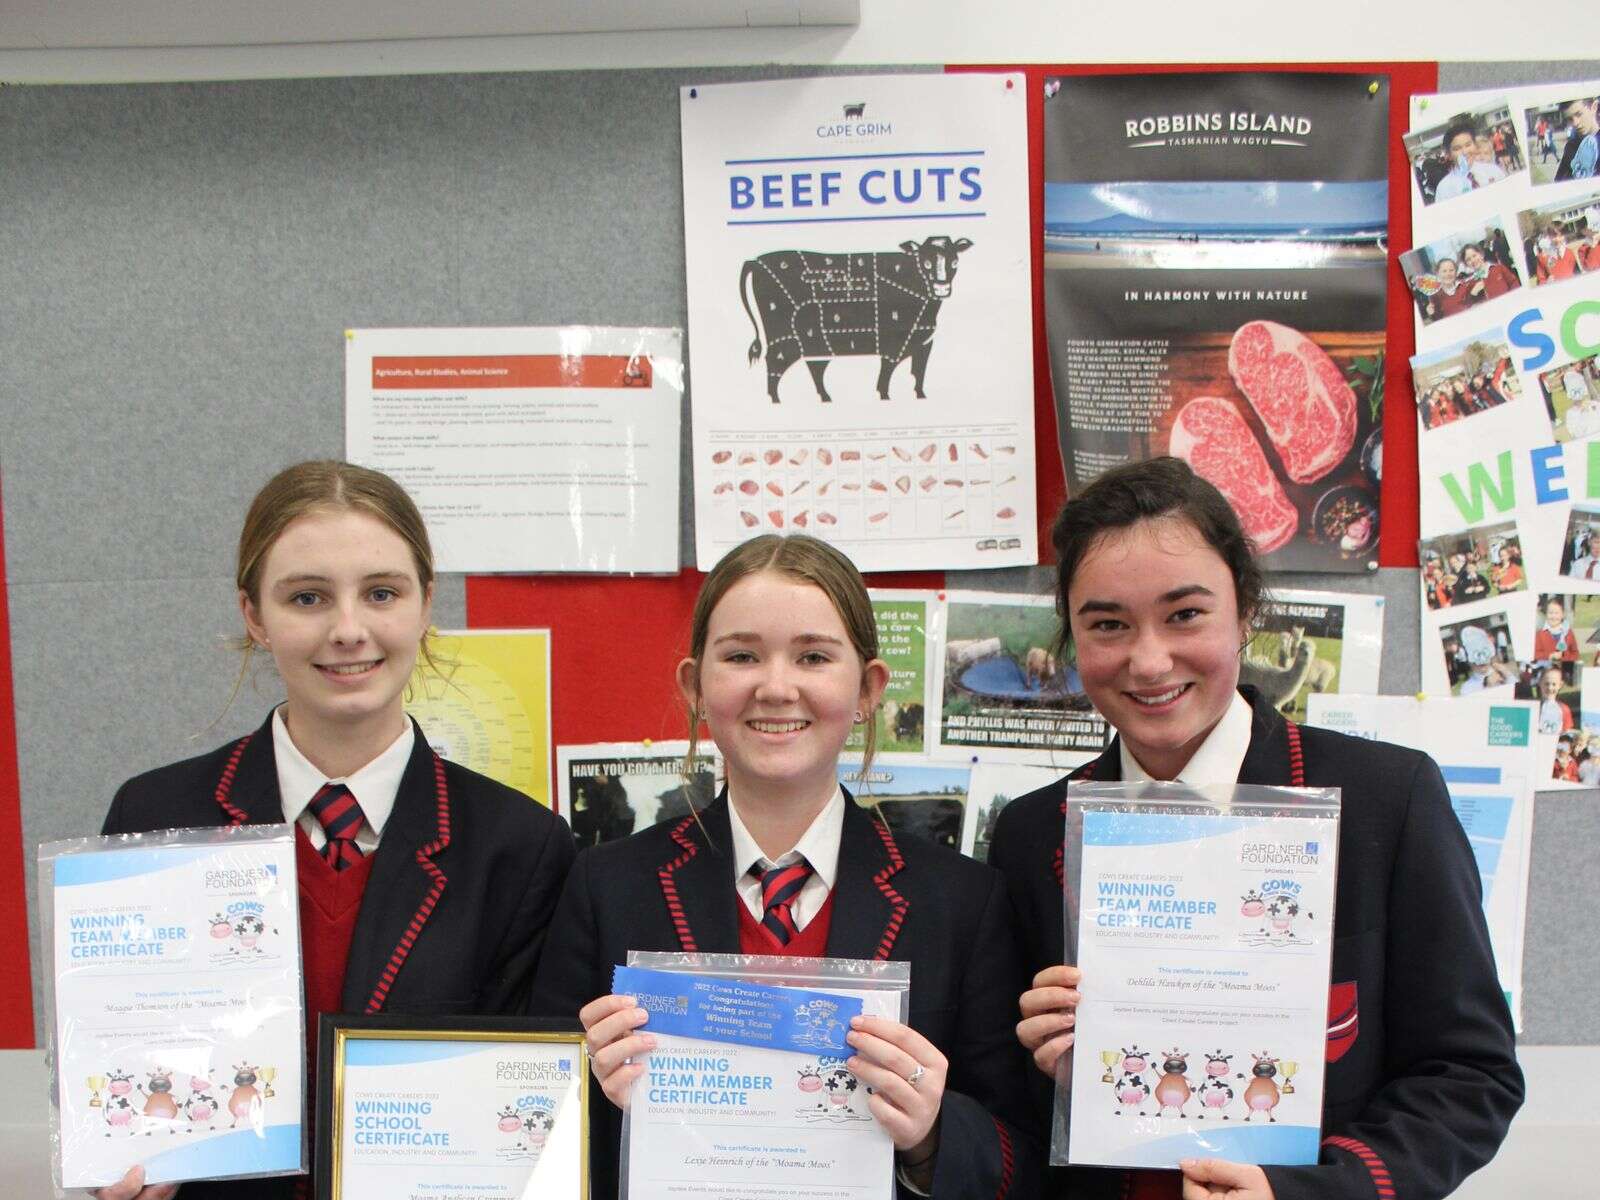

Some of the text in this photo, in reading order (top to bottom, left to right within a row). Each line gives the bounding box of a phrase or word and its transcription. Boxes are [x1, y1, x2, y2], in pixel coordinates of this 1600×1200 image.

[816, 124, 892, 138] CAPE GRIM
[1125, 112, 1312, 137] ROBBINS ISLAND
[1168, 137, 1268, 147] TASMANIAN WAGYU
[730, 167, 982, 209] BEEF CUTS
[1125, 291, 1308, 301] IN HARMONY WITH NATURE
[376, 369, 414, 377] Agriculture,
[881, 611, 897, 620] did
[900, 611, 919, 620] the
[890, 624, 912, 632] cow
[878, 635, 910, 644] to the
[947, 716, 966, 728] AND
[968, 716, 1002, 728] PHYLLIS
[1004, 718, 1025, 729] WAS
[1027, 719, 1055, 730] NEVER
[1093, 722, 1104, 733] TO
[947, 729, 988, 741] ANOTHER
[990, 731, 1044, 744] TRAMPOLINE
[1075, 735, 1104, 747] AGAIN
[572, 764, 600, 777] HAVE
[603, 763, 625, 776] YOU
[628, 763, 650, 776] GOT
[1241, 854, 1319, 864] FOUNDATION
[1098, 882, 1175, 897] WINNING
[1262, 879, 1302, 894] COWS
[227, 901, 264, 913] COWS
[1097, 898, 1216, 914] TEAM MEMBER
[70, 930, 113, 944] TEAM
[71, 943, 164, 958] CERTIFICATE
[694, 982, 711, 992] 2022
[712, 984, 732, 994] Cows
[734, 987, 760, 998] Create
[1192, 980, 1202, 992] of
[1203, 981, 1216, 989] the
[170, 1002, 179, 1011] of
[181, 1001, 192, 1009] the
[712, 1003, 736, 1016] being
[738, 1007, 754, 1017] part
[706, 1013, 773, 1030] Winning Team
[715, 1026, 737, 1037] your
[740, 1029, 773, 1040] School
[496, 1062, 557, 1071] GARDINER
[649, 1057, 729, 1072] WINNING
[496, 1071, 571, 1080] FOUNDATION
[649, 1073, 773, 1089] TEAM MEMBER
[516, 1095, 556, 1109] COWS
[649, 1089, 747, 1105] CERTIFICATE
[355, 1101, 432, 1114] WINNING
[355, 1117, 422, 1129] SCHOOL
[355, 1132, 449, 1145] CERTIFICATE
[684, 1156, 835, 1169] Lexie Heinrich of the "Moama Moos"
